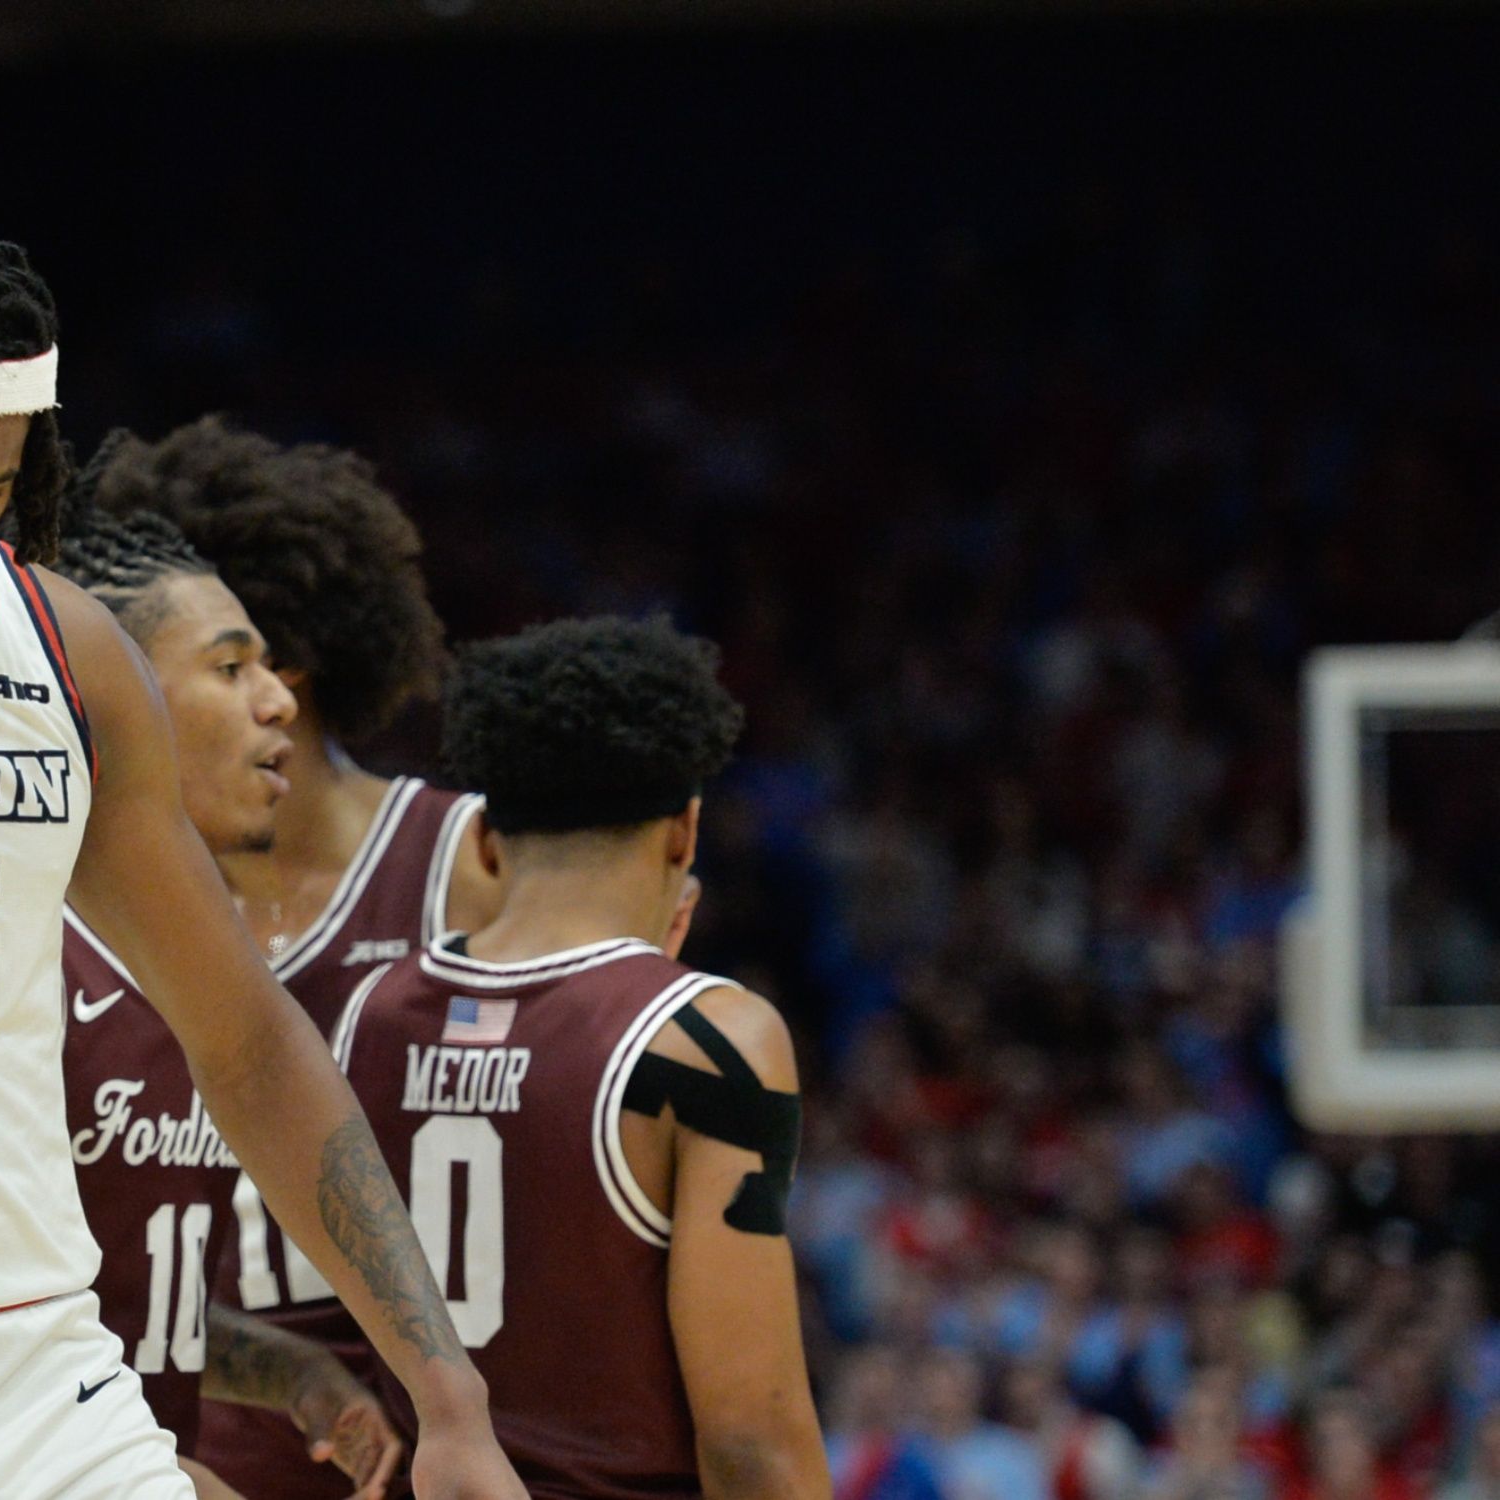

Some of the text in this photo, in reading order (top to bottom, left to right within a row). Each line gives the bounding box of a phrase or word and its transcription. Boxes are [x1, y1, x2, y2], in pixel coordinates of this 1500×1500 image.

[401, 1044, 531, 1113] MEDOR
[134, 1203, 213, 1374] 10
[410, 1116, 505, 1349] 0
